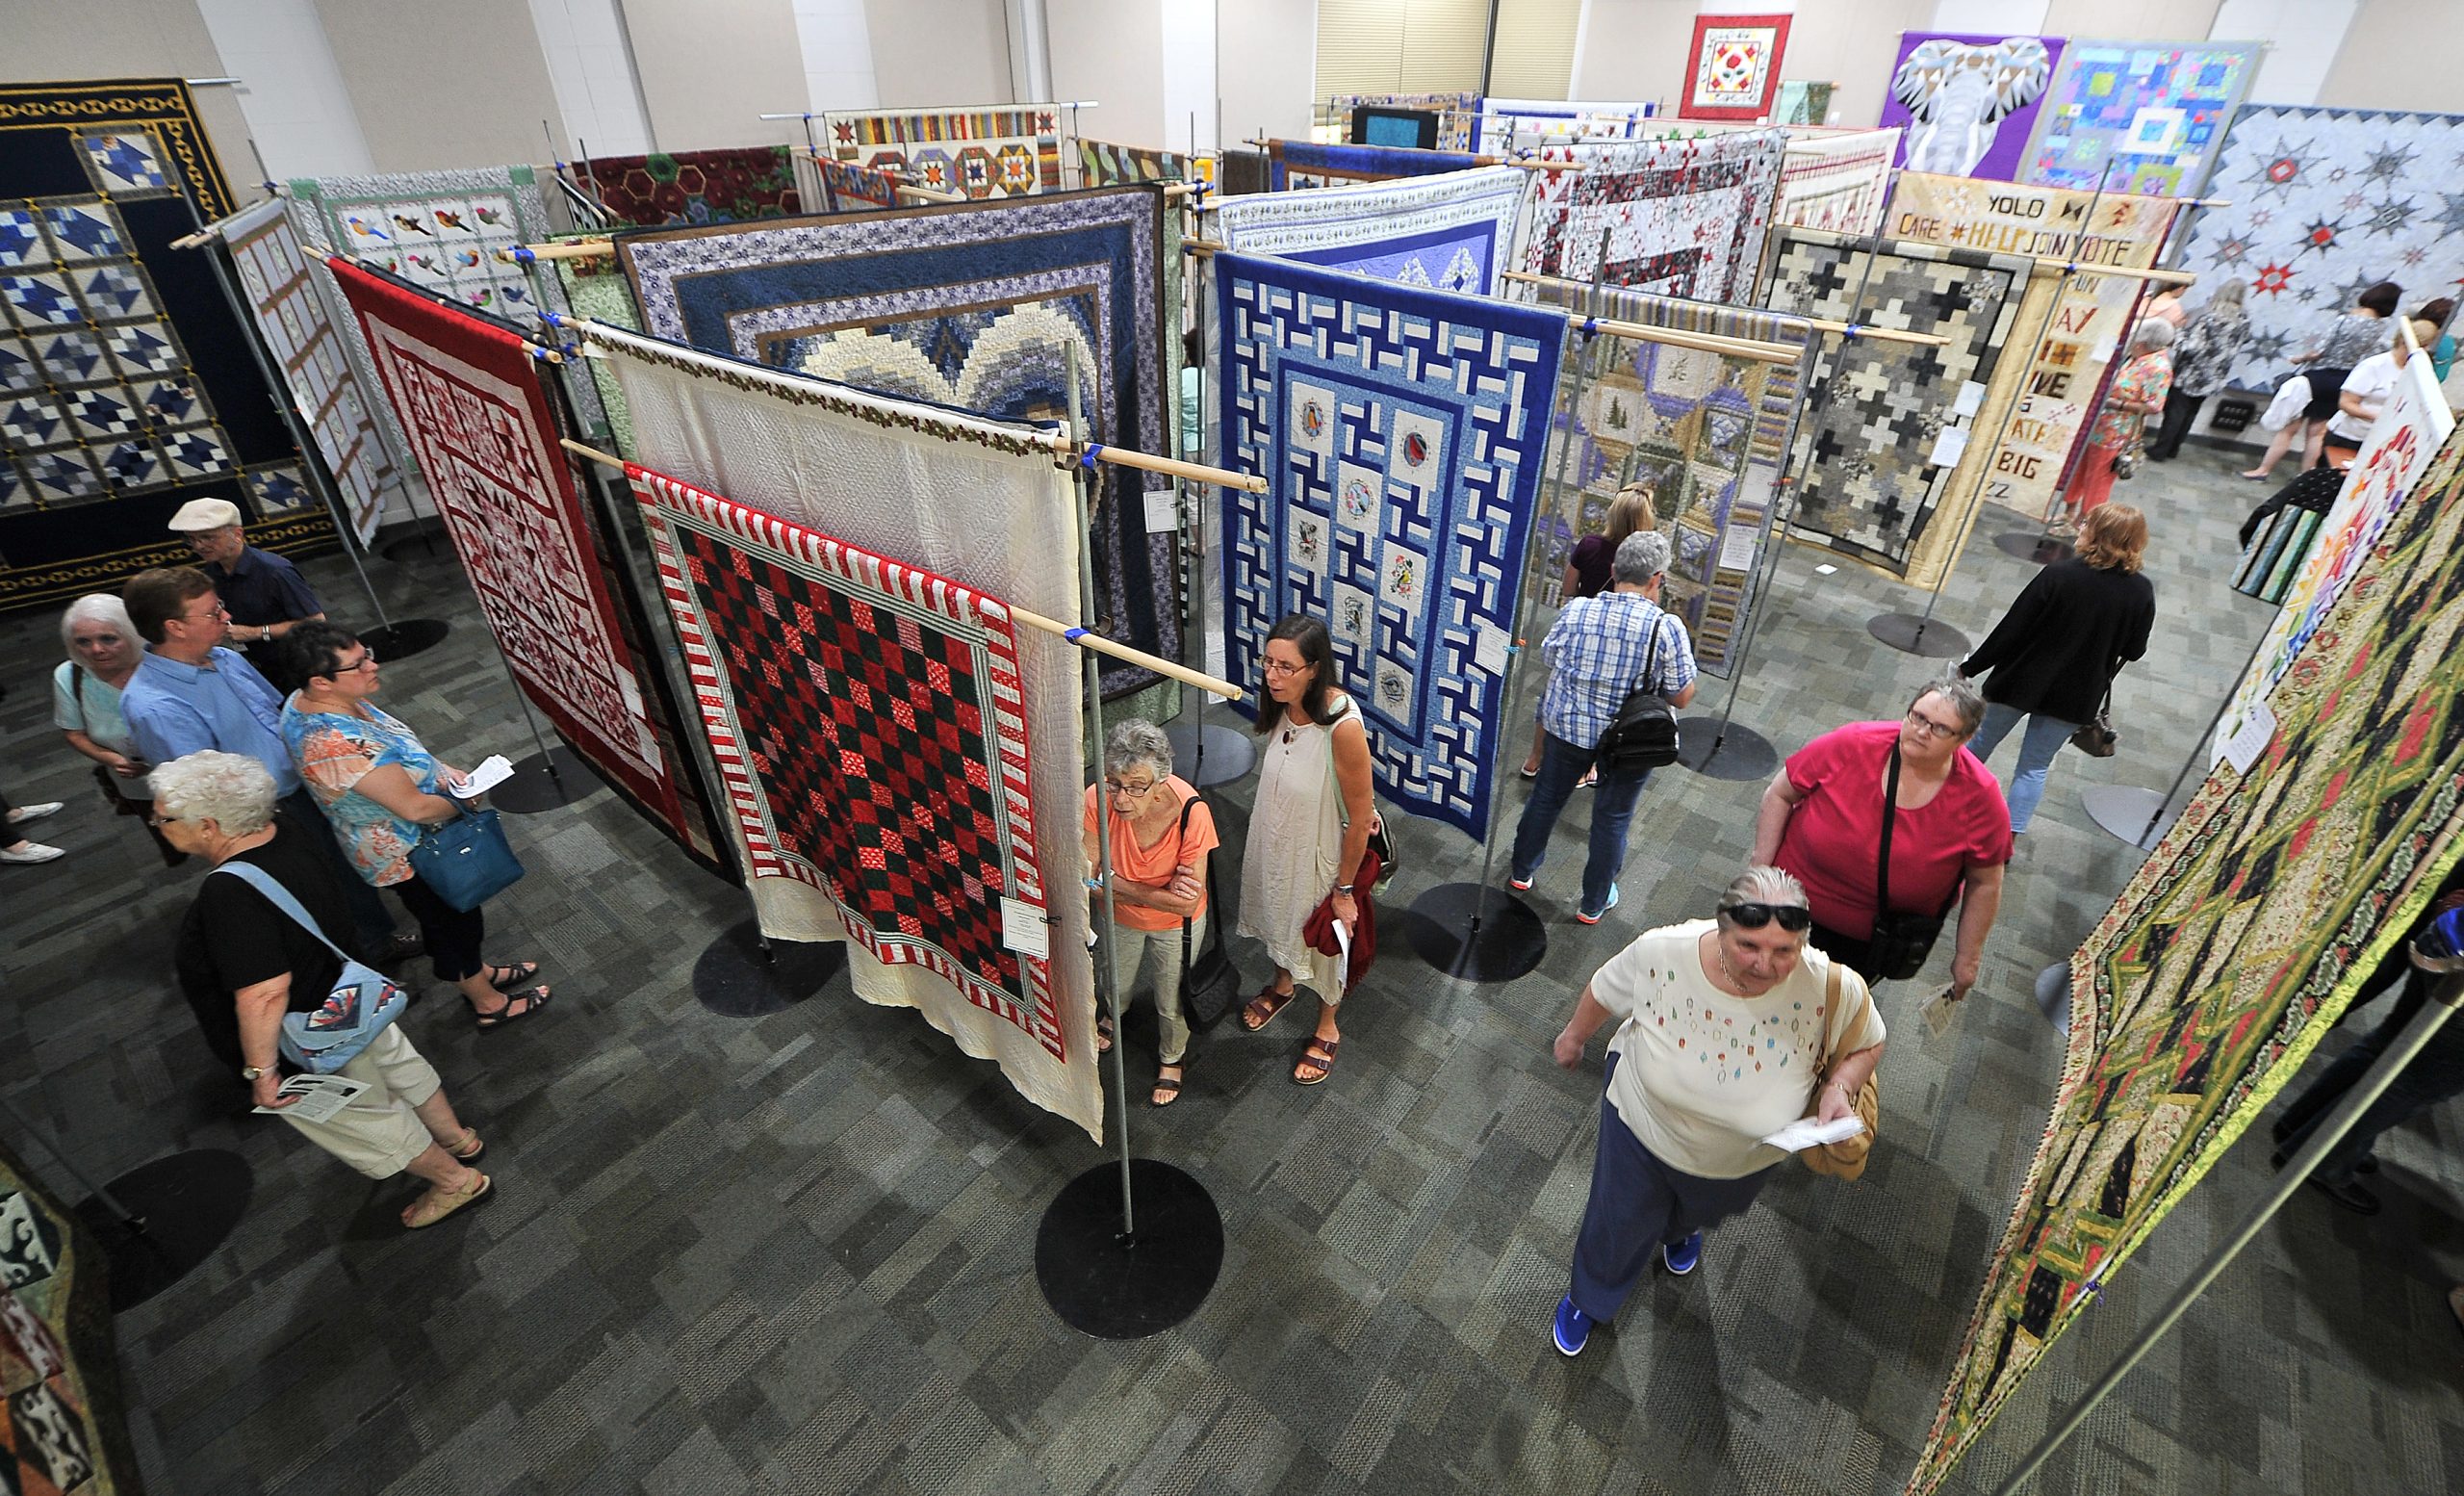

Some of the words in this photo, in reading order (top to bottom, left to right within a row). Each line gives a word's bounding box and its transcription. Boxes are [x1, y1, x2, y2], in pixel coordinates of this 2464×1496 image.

[1989, 193, 2045, 219] YOLO
[1899, 213, 1940, 240] CARE
[1966, 221, 2027, 252] HELP
[2072, 235, 2133, 266] VOTE
[1996, 451, 2042, 479] BIG
